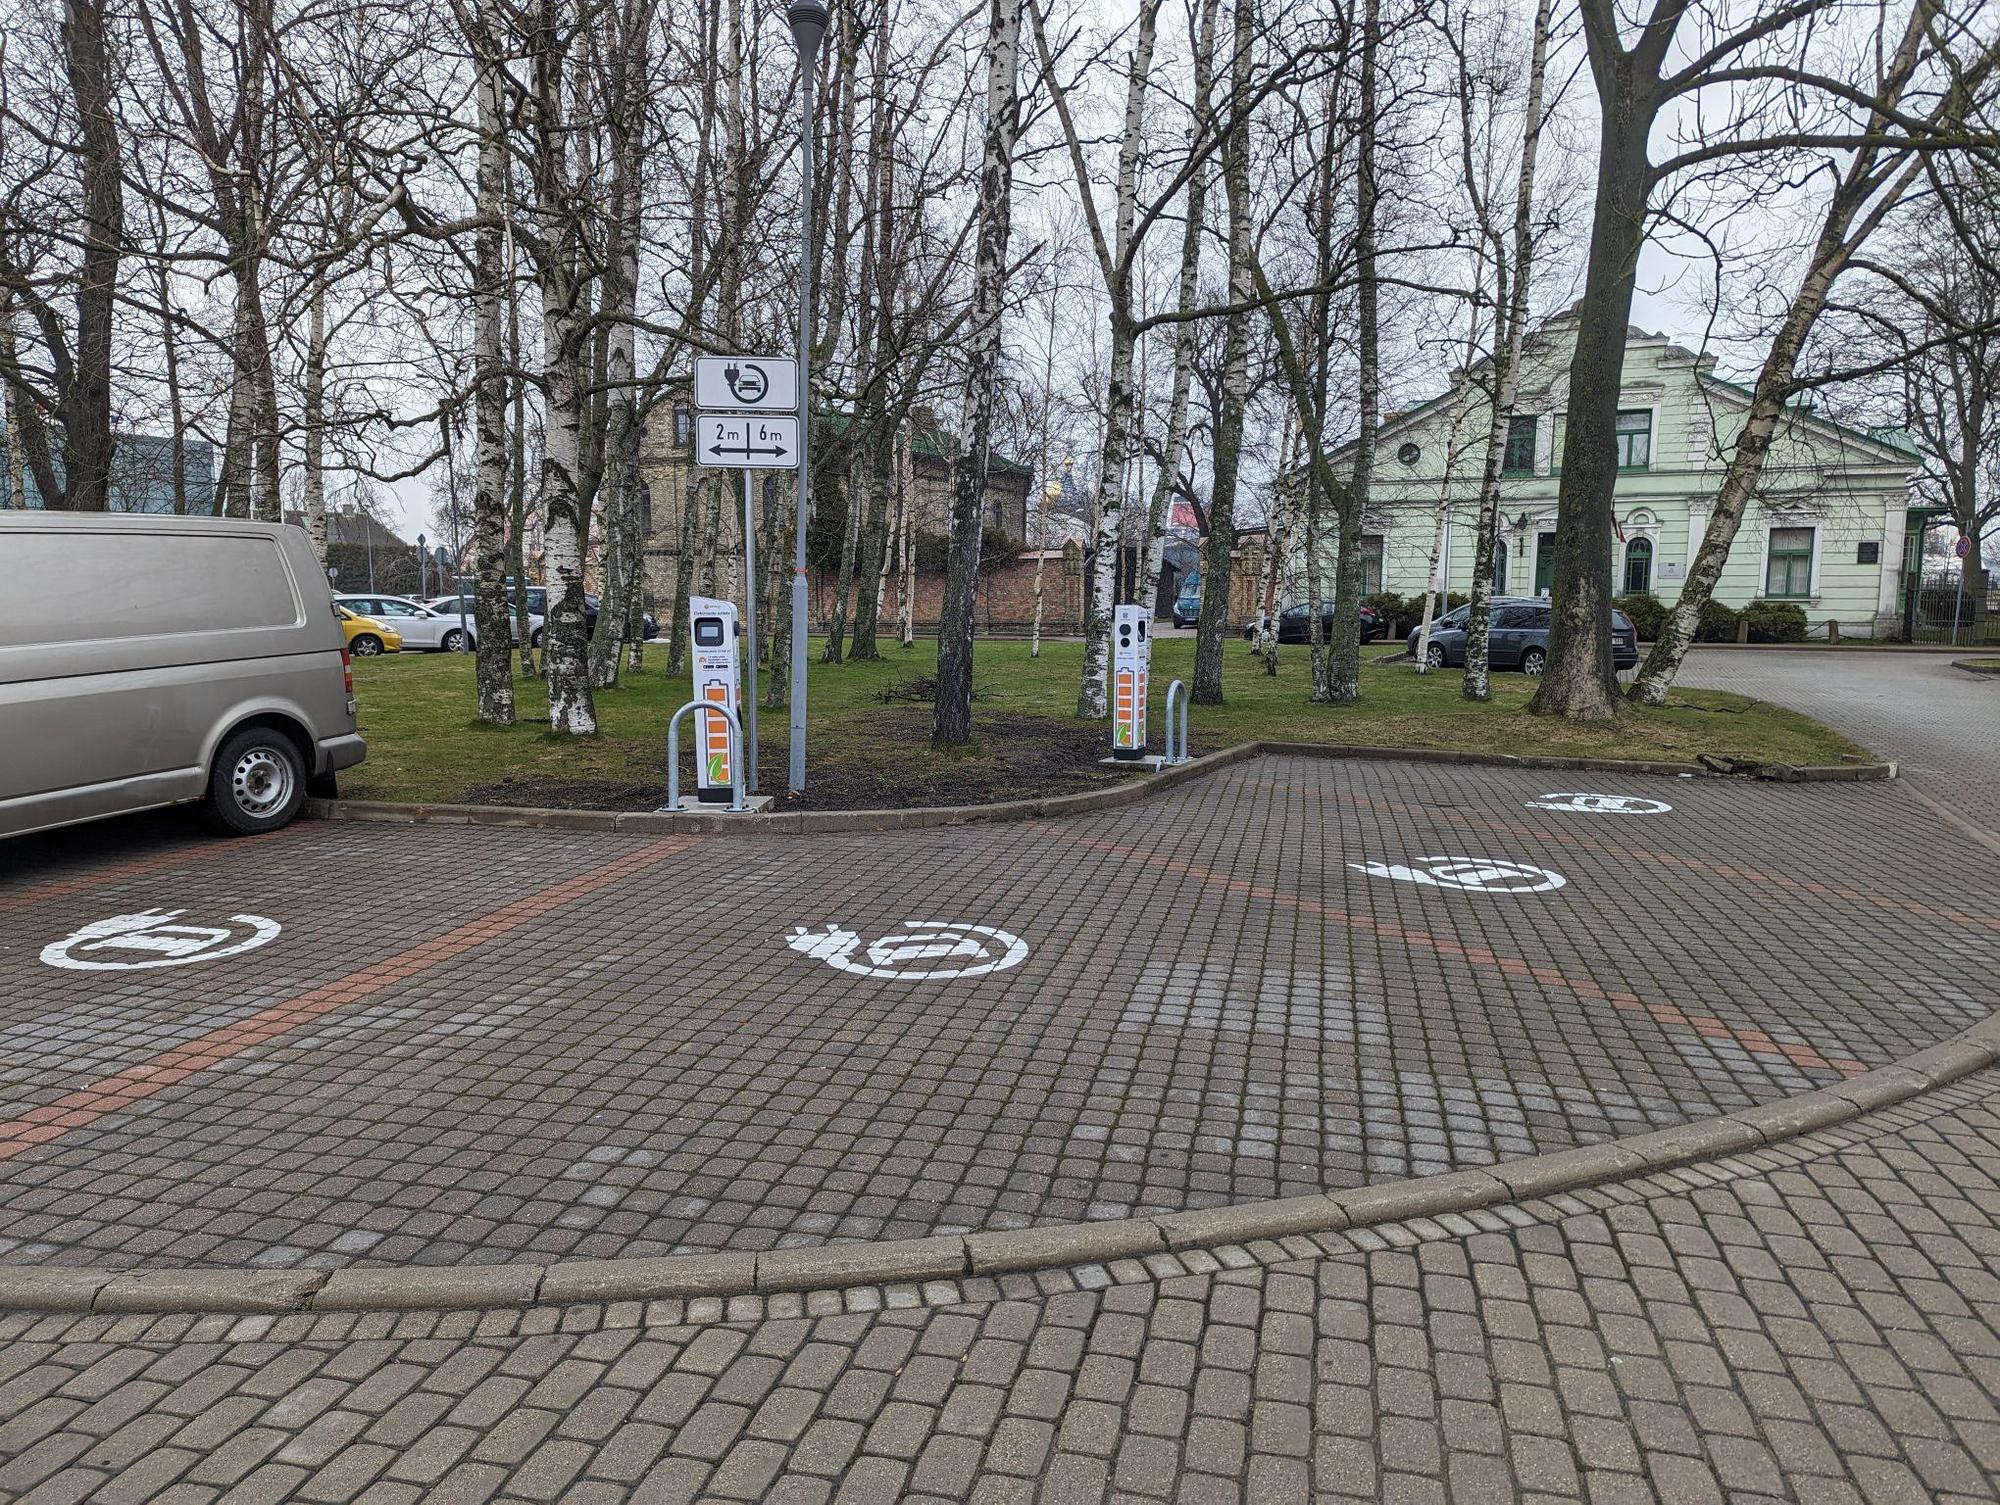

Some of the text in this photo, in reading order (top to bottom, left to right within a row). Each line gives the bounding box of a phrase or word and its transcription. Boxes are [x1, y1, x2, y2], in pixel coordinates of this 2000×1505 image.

[716, 423, 739, 441] 2 m
[759, 424, 782, 441] 6 m
